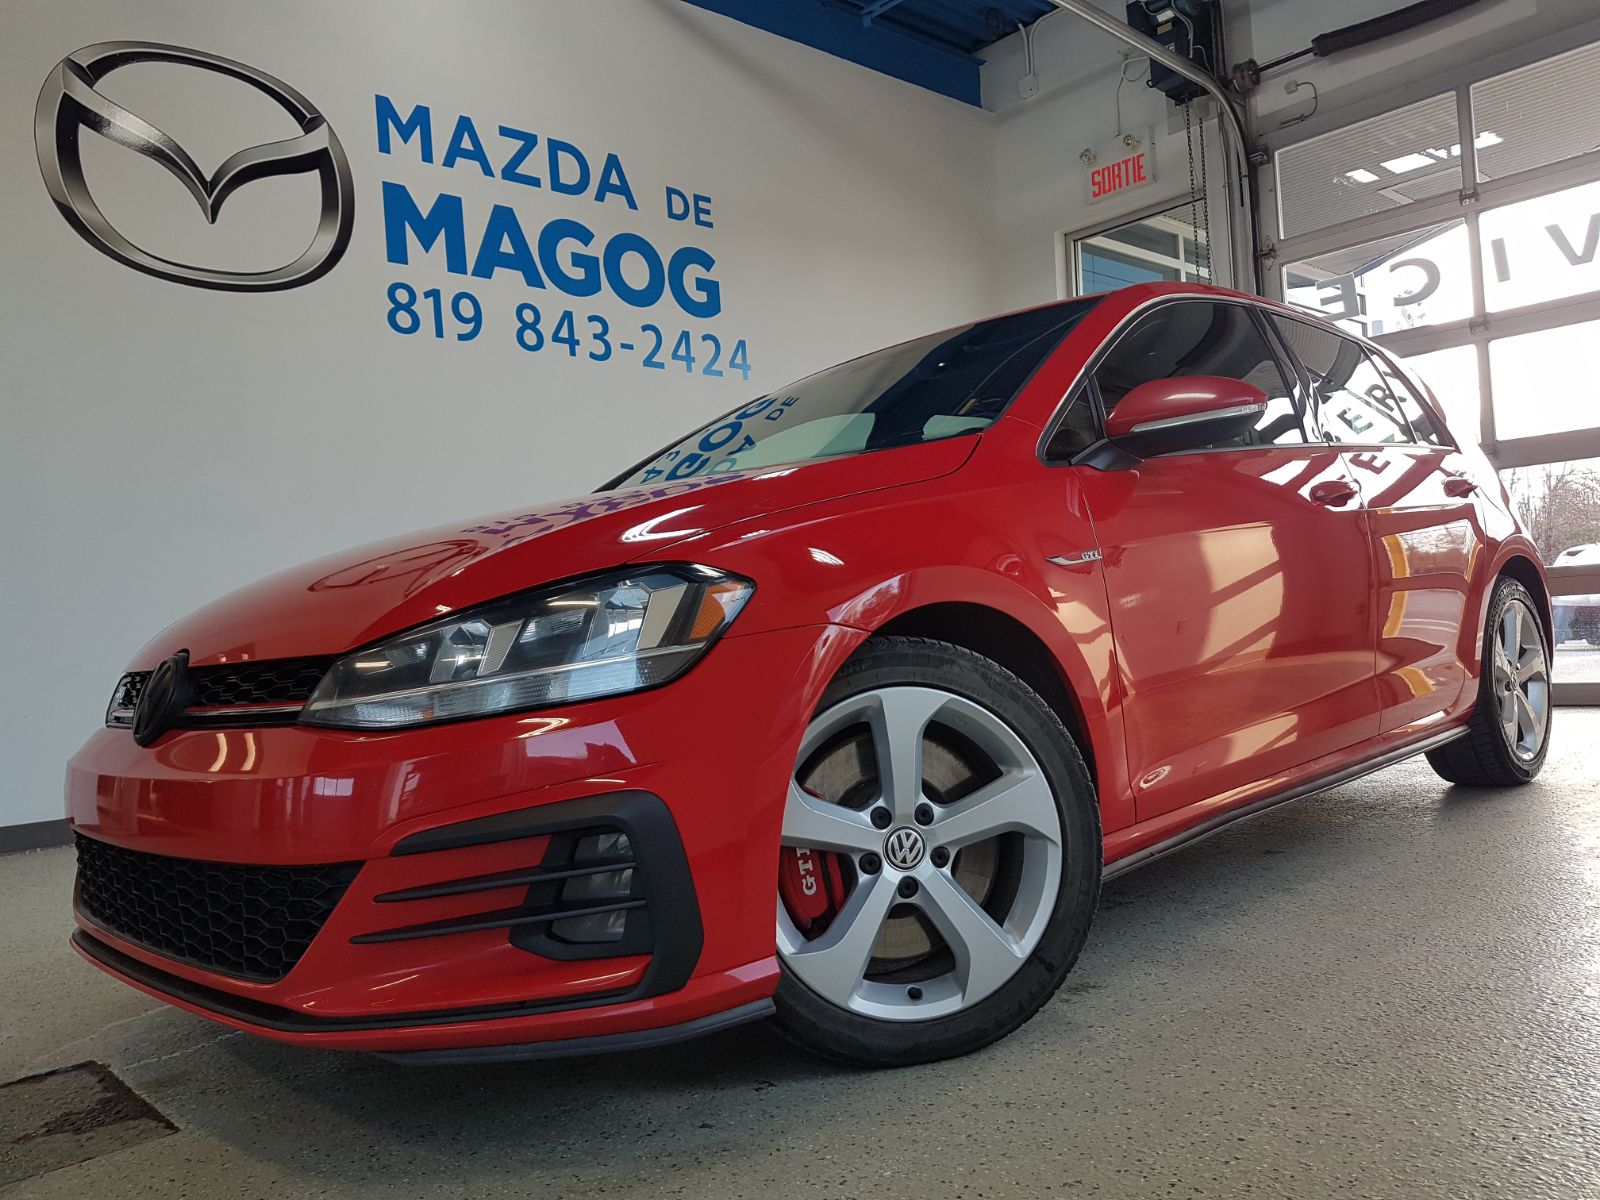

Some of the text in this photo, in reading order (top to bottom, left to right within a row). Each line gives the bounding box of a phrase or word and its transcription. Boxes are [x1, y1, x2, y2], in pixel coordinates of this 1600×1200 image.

[375, 94, 714, 228] MAZDA DE
[1091, 152, 1147, 199] SORTIE
[382, 181, 721, 318] MAGOG
[387, 282, 751, 380] 819 843-2424
[796, 846, 817, 896] GTI
